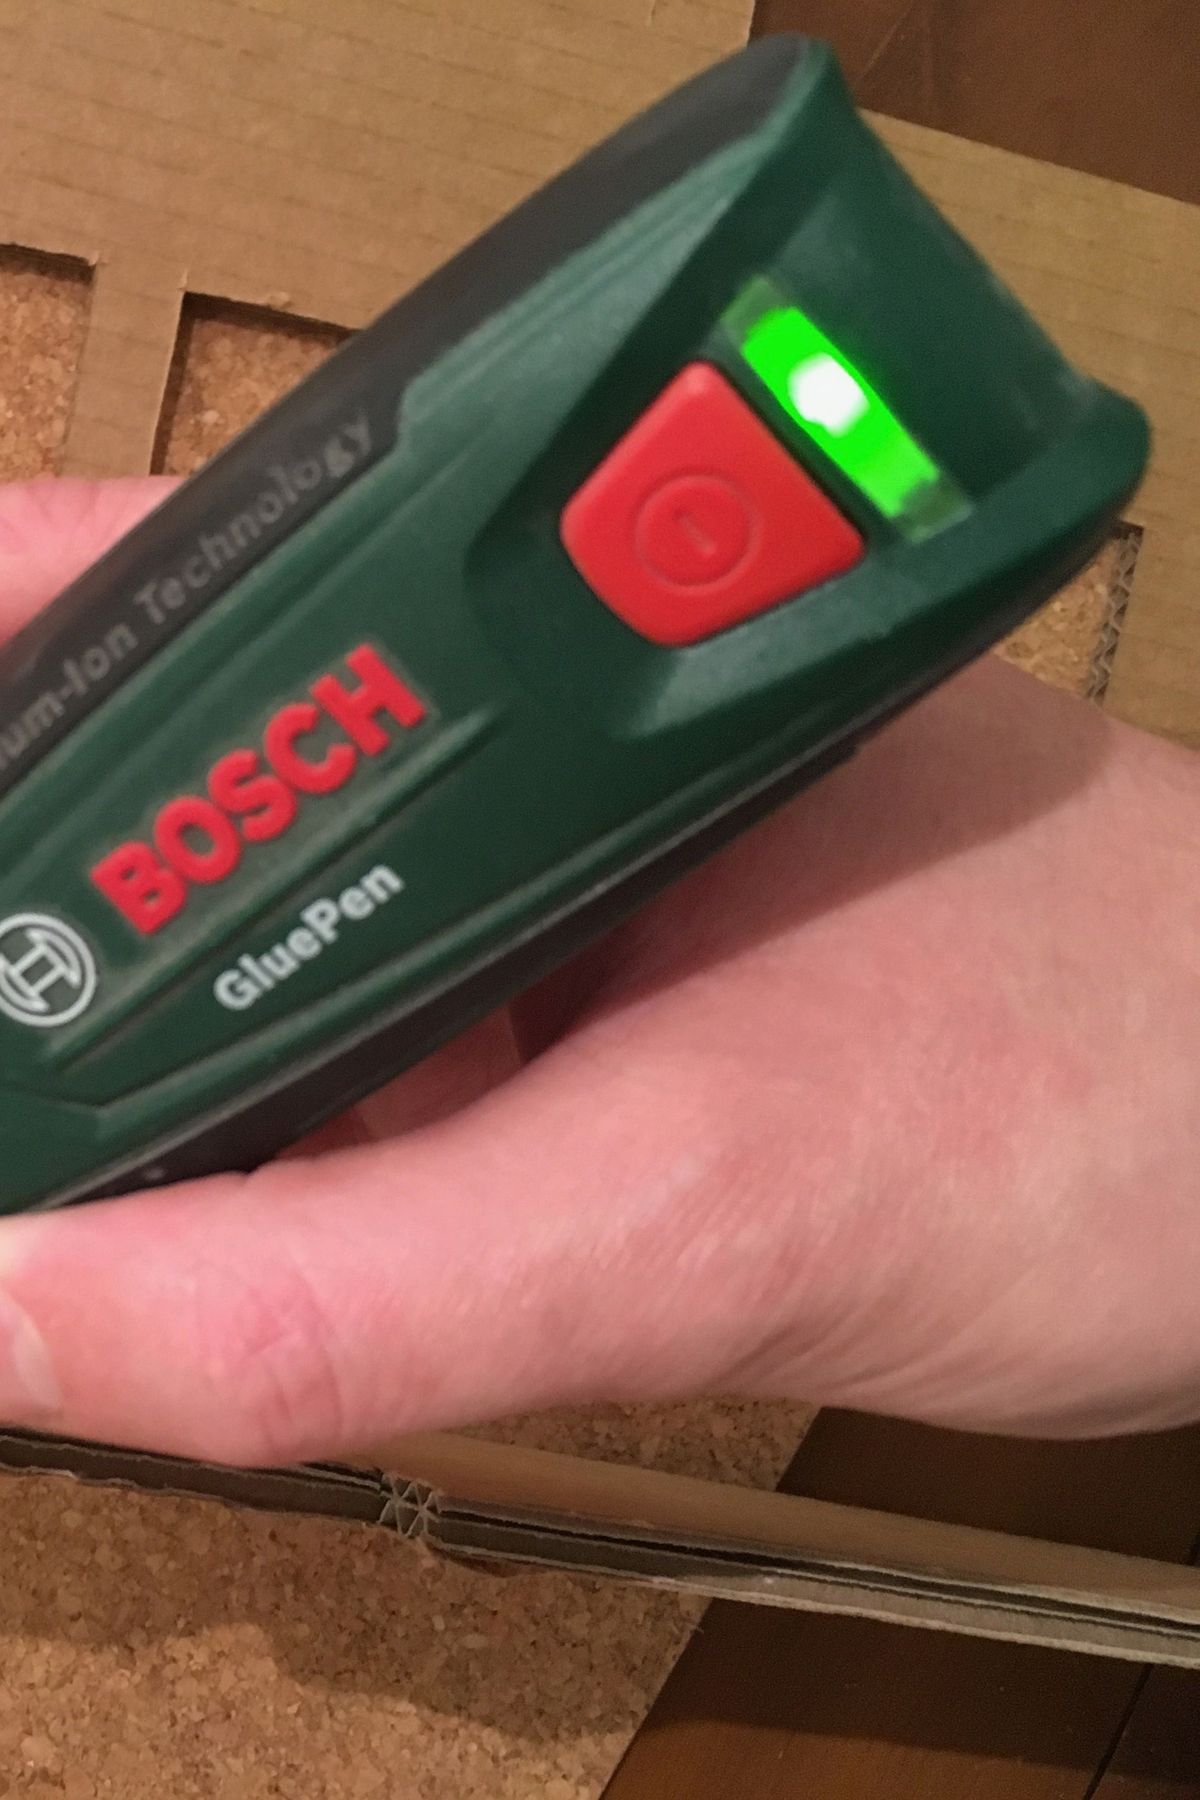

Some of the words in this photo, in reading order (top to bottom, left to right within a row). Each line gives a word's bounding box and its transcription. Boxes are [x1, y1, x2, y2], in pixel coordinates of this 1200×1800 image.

[133, 416, 373, 624] Technology
[90, 642, 427, 934] BOSCH
[213, 864, 405, 1011] GluePen
